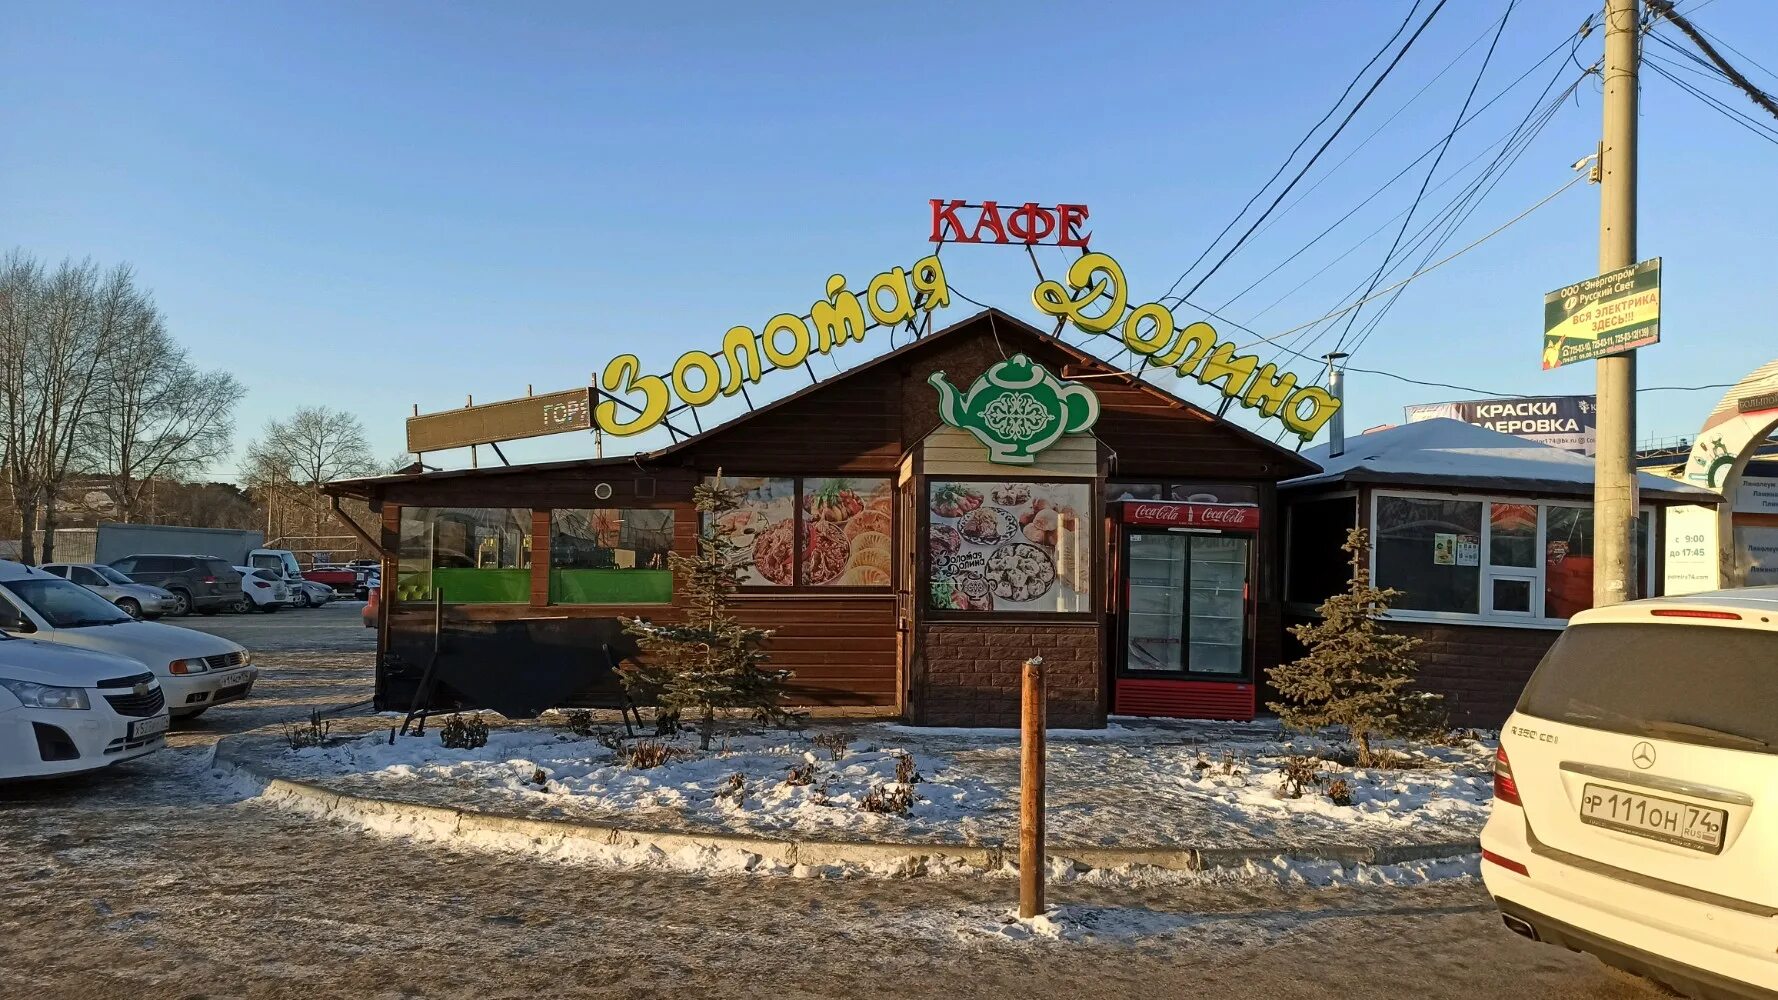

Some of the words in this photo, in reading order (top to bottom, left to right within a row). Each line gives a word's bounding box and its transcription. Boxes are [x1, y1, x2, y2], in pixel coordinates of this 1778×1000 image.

[929, 199, 1091, 248] КАФЕ
[1560, 285, 1580, 299] ООО
[1581, 265, 1639, 291] "Энергопром"
[1580, 286, 1613, 304] Русский
[1614, 280, 1635, 293] Свет
[1572, 311, 1592, 325] ВСЯ
[1595, 293, 1657, 319] ЭЛЕКТРИКА
[1592, 311, 1634, 332] ЗДЕСЬ!!!
[594, 254, 951, 438] Золотая
[1031, 252, 1343, 441] Долина
[1476, 402, 1557, 418] КРАСКИ
[1471, 418, 1580, 433] ЛЕРОВКА
[1753, 490, 1778, 498] Ламина
[1135, 504, 1181, 520] Coca-Cola
[1201, 507, 1247, 523] Coca-Cola
[1684, 534, 1705, 543] 9:00
[937, 549, 983, 567] Золотая
[1669, 550, 1681, 558] до
[1682, 548, 1705, 557] 17:45
[946, 558, 985, 577] Долина
[1688, 808, 1712, 833] 74
[1684, 827, 1702, 839] RUS
